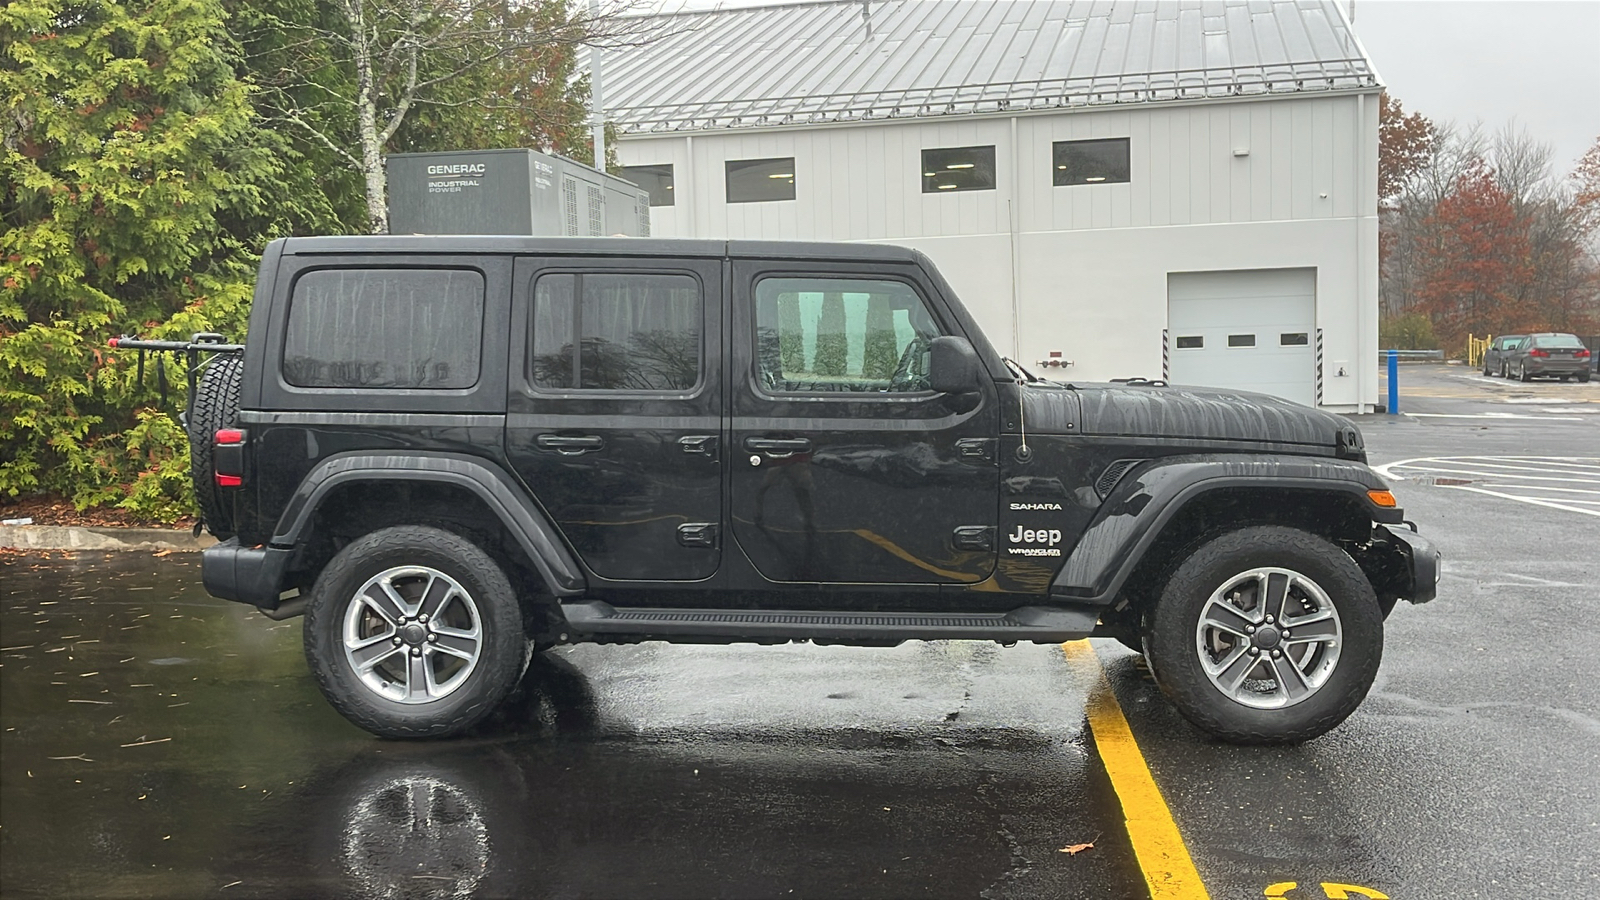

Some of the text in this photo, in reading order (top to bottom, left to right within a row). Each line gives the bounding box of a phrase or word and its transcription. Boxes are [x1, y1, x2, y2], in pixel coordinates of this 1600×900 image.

[428, 164, 486, 174] GENERAC
[428, 180, 480, 188] INDUSTRIAL
[1008, 525, 1062, 547] Jeep
